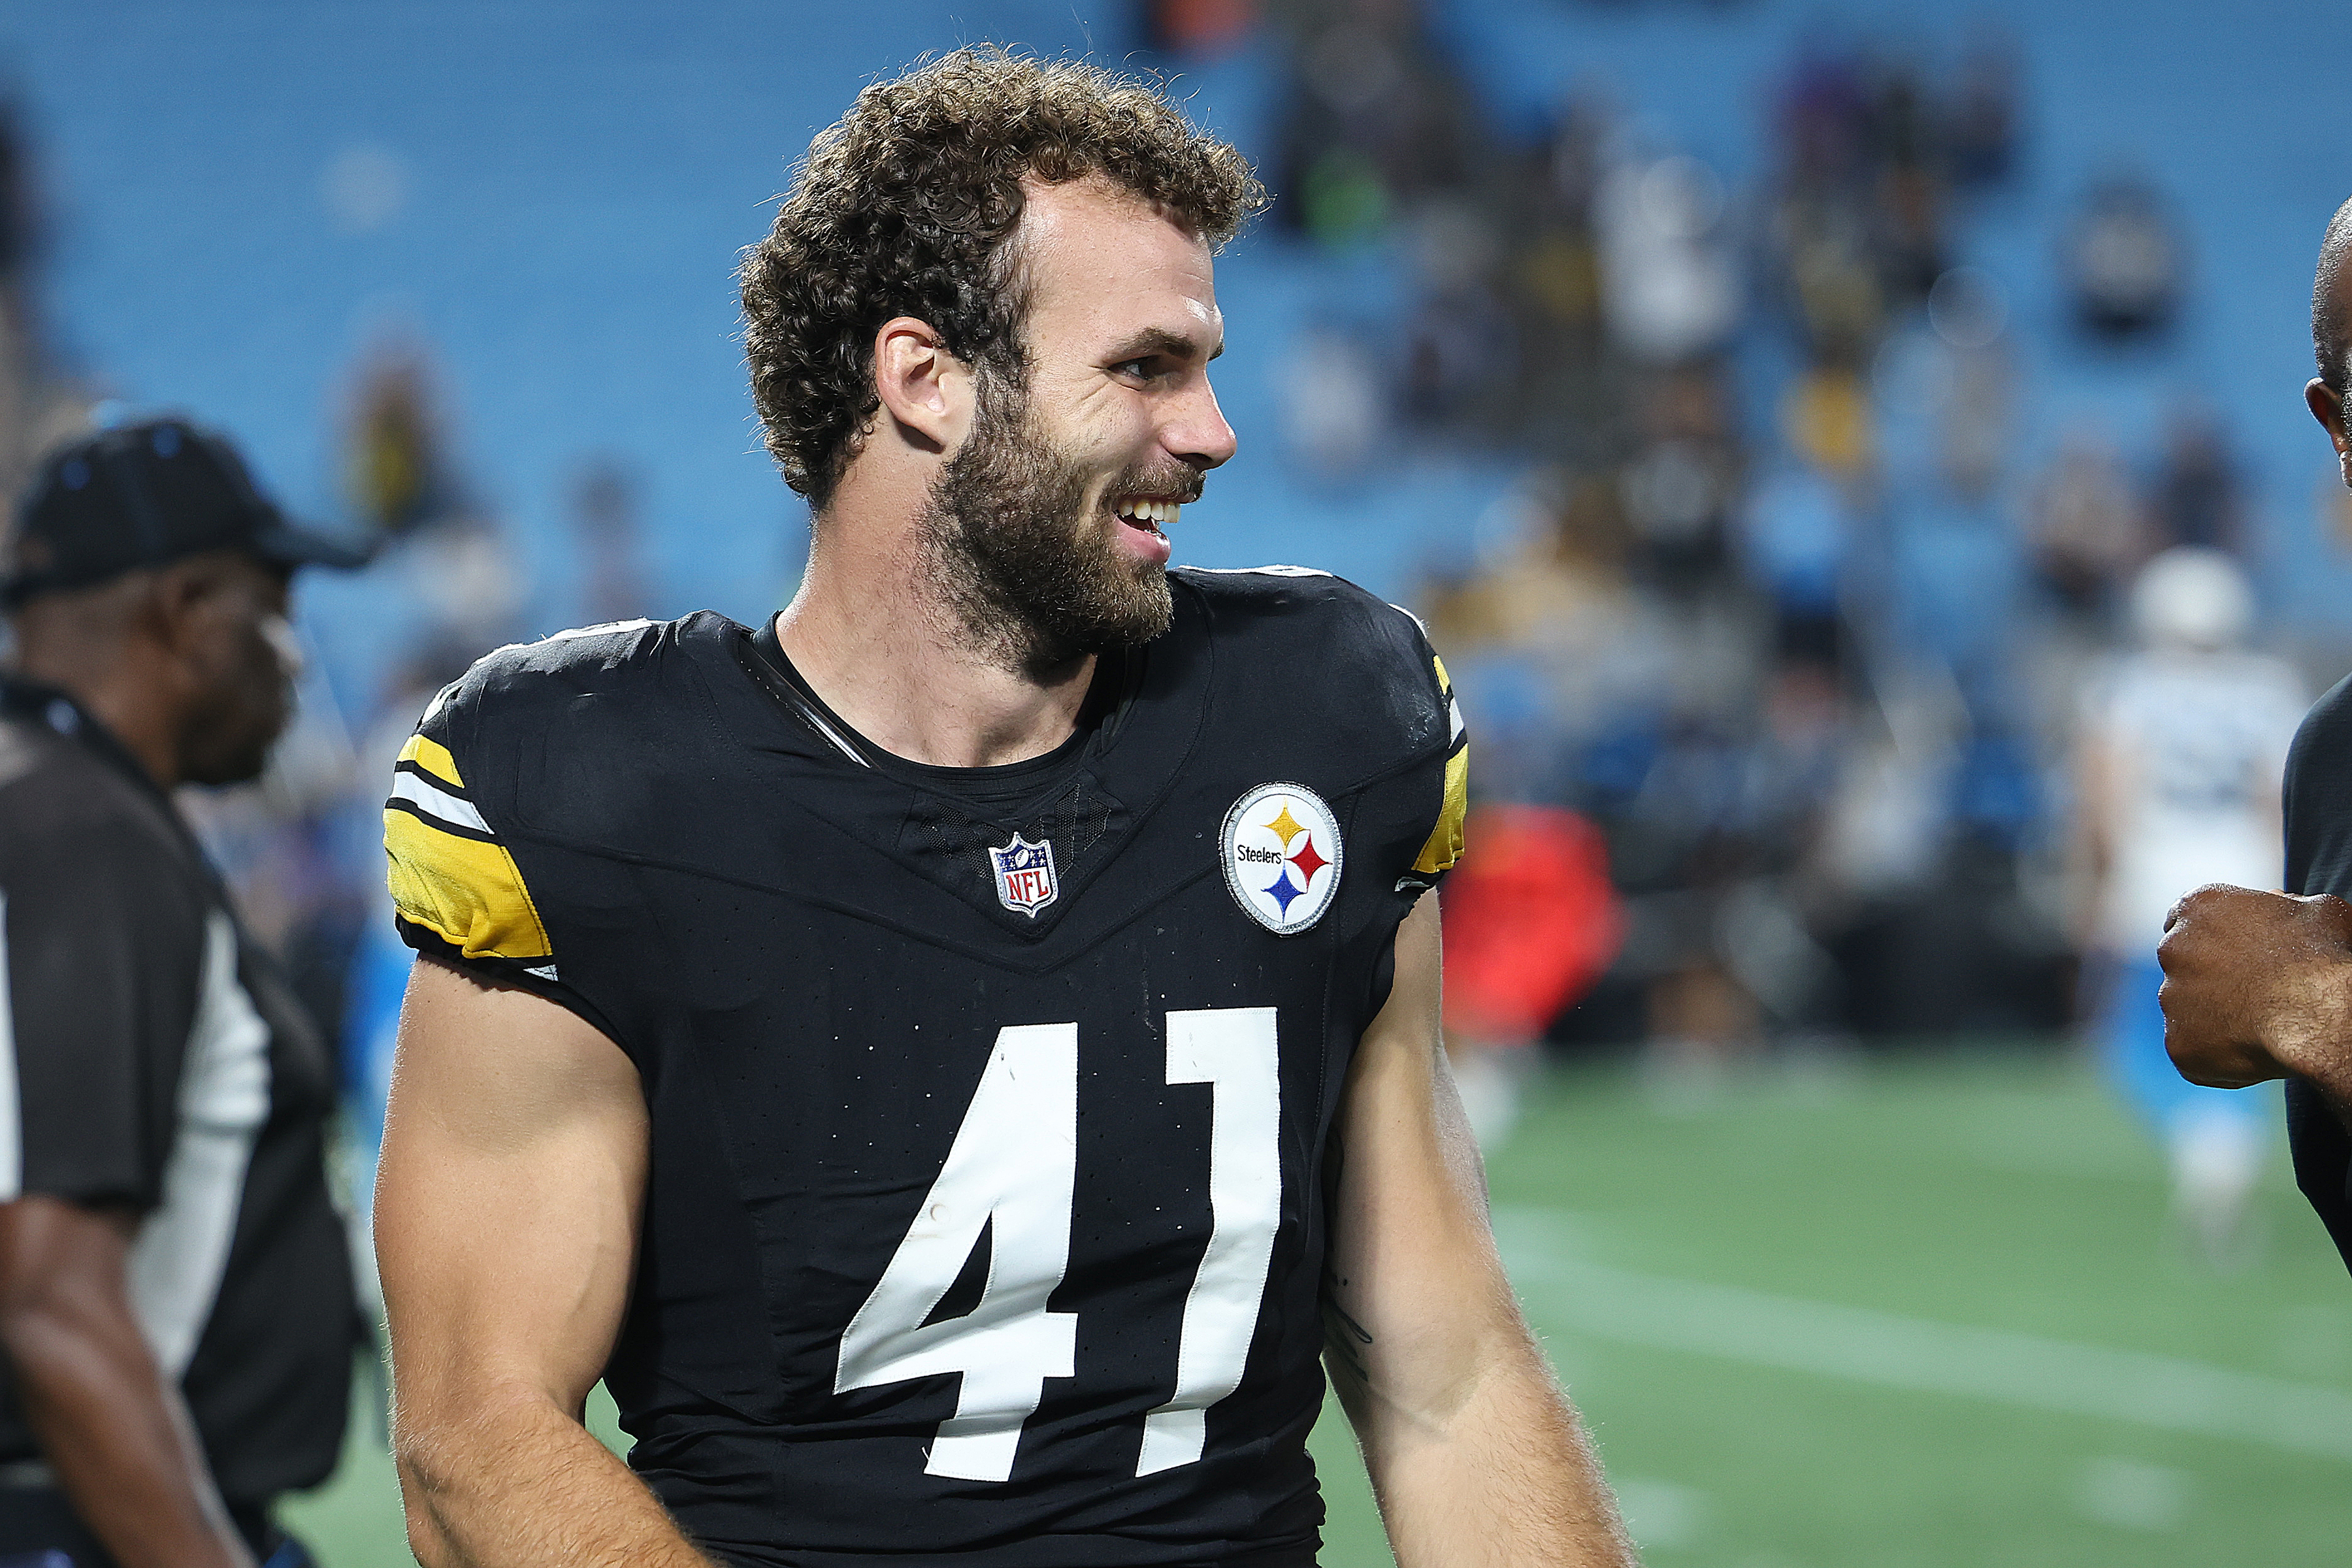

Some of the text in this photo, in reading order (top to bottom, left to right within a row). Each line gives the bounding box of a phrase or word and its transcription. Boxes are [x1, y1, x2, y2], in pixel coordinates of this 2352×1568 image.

[1237, 845, 1282, 864] Steelers
[1006, 871, 1049, 902] NFL
[833, 1007, 1282, 1482] 41
